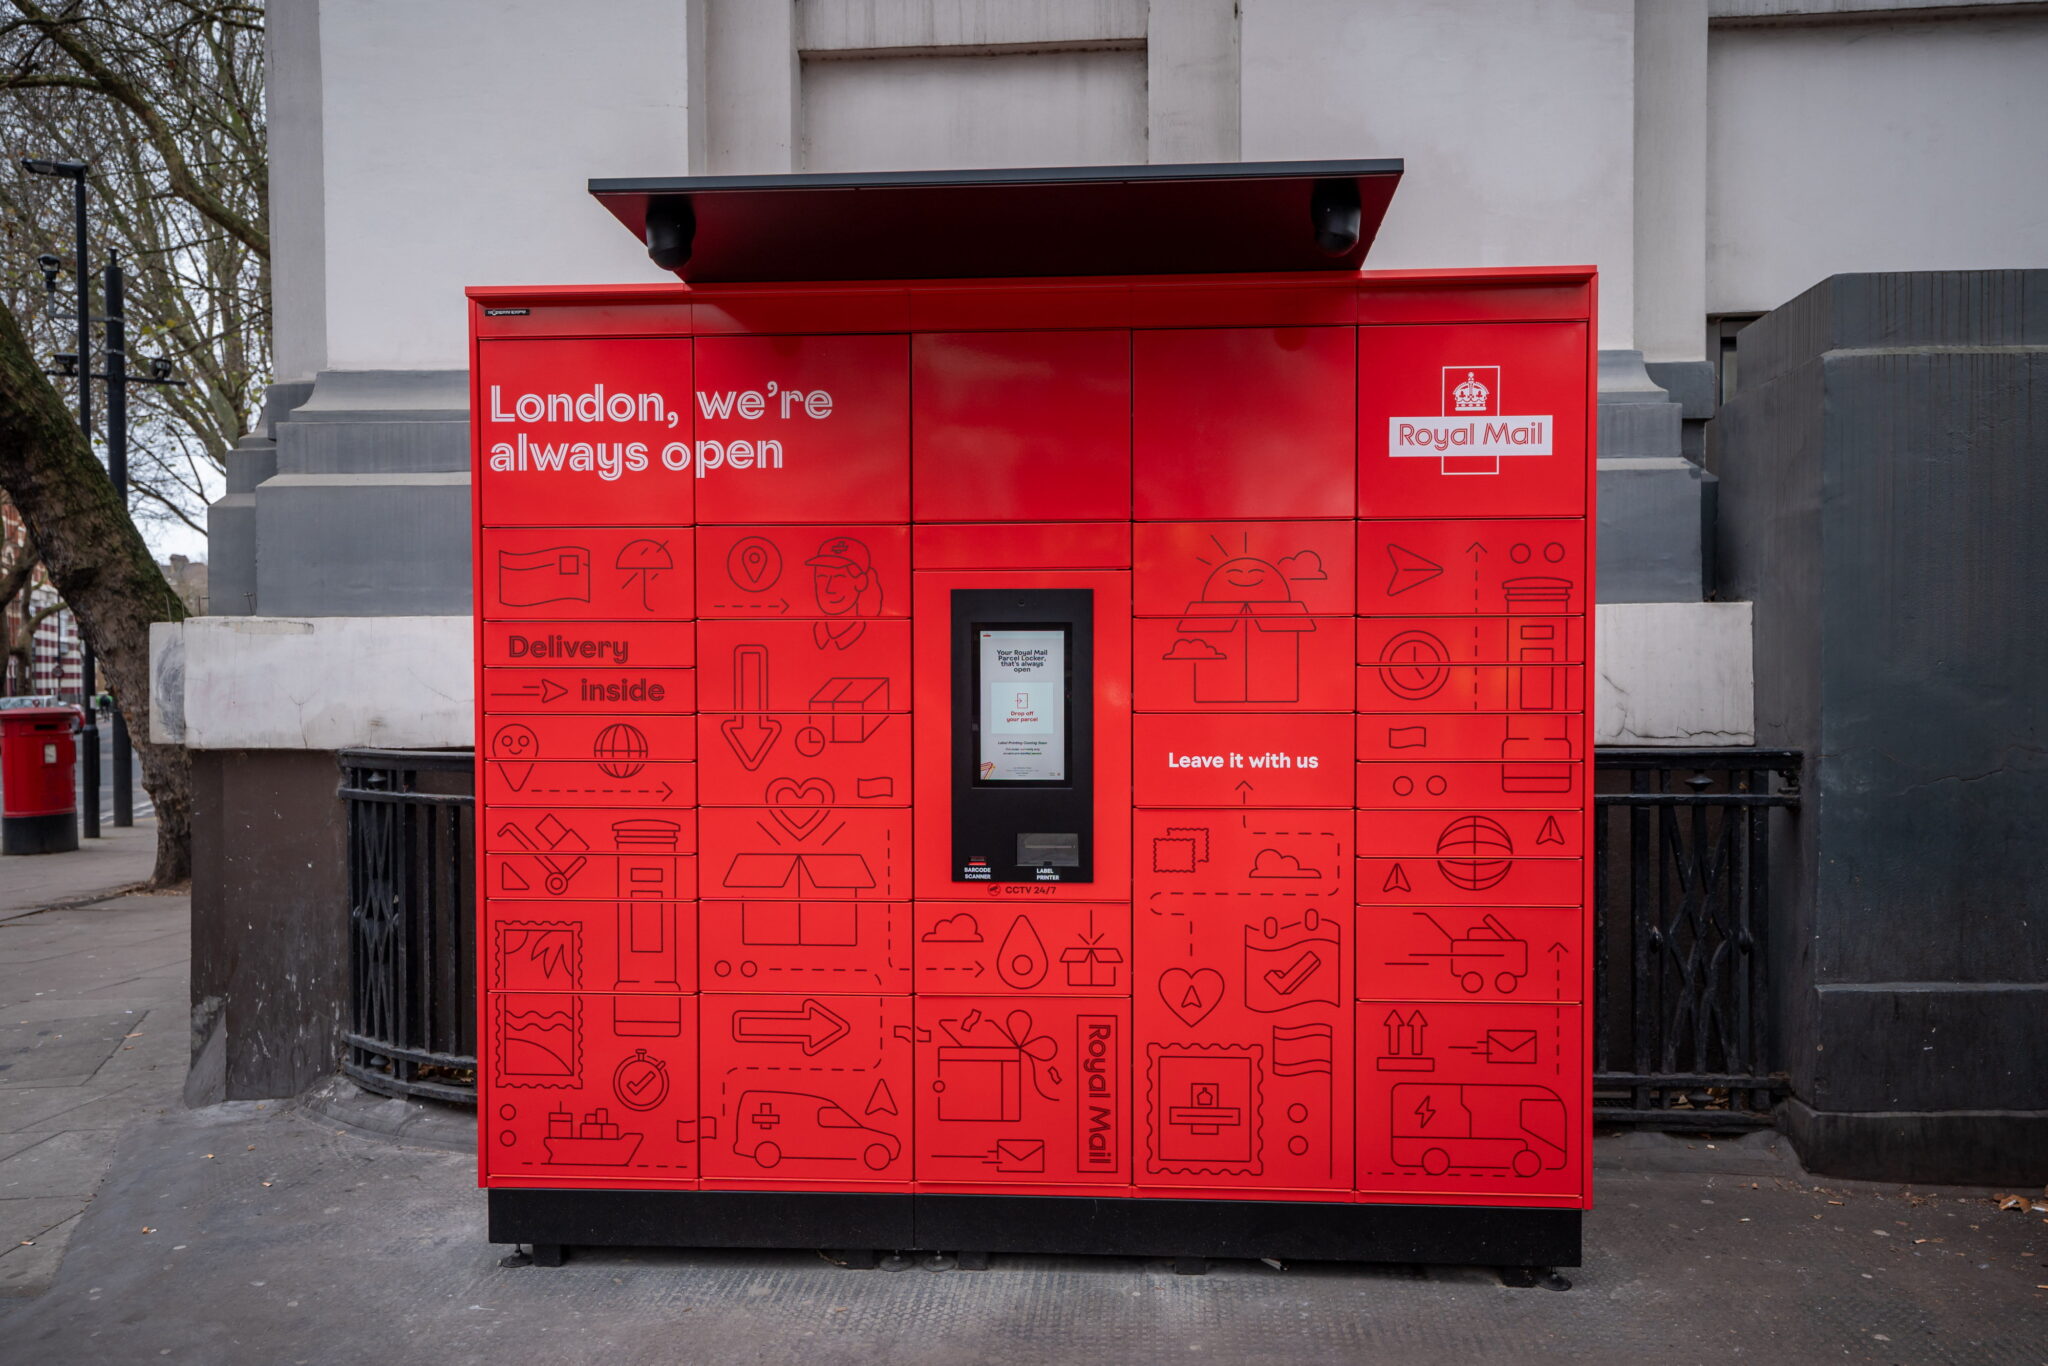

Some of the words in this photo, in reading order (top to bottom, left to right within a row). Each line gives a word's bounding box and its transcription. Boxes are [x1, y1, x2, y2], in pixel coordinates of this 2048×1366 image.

[489, 383, 679, 428] London,
[696, 380, 833, 420] we’re
[1399, 423, 1475, 451] Royal
[1482, 422, 1543, 445] Mail
[489, 433, 649, 481] always
[661, 438, 784, 478] open
[508, 635, 629, 664] Delivery
[1014, 649, 1033, 657] Royal
[580, 678, 665, 702] inside
[1168, 752, 1224, 768] Leave
[1229, 752, 1244, 768] it
[1248, 752, 1291, 768] with
[1296, 756, 1319, 768] us
[1005, 886, 1031, 894] CCTV
[1033, 886, 1056, 894] 24/7
[1083, 1024, 1111, 1098] Royal
[1088, 1105, 1112, 1164] Mail
